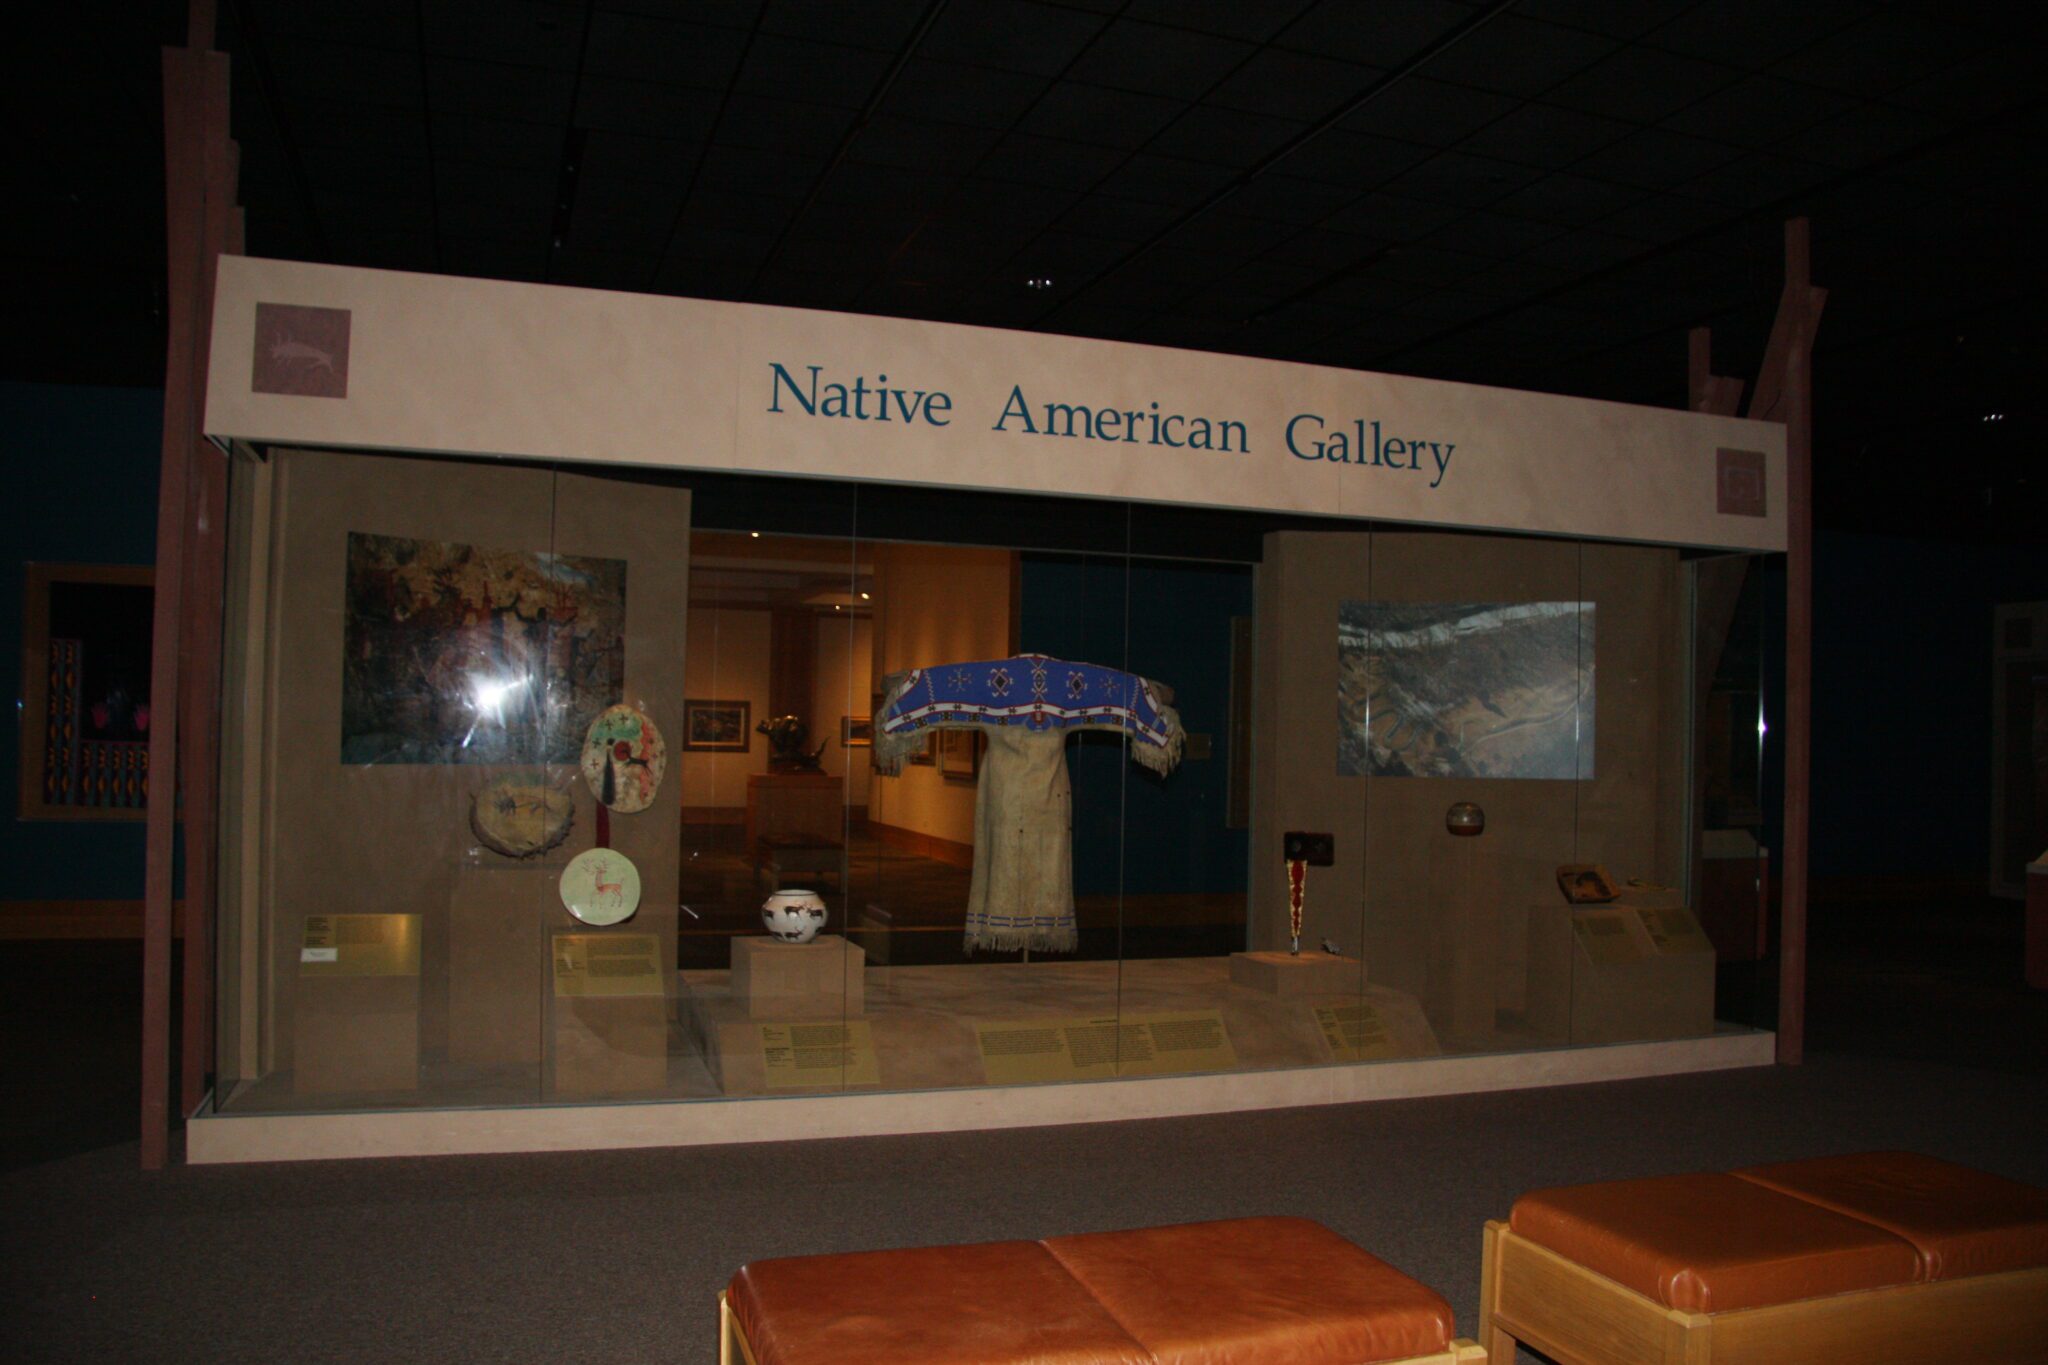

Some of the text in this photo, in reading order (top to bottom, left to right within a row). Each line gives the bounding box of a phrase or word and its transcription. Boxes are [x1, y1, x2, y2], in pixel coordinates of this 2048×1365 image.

[768, 363, 1457, 489] Native American Gallery
